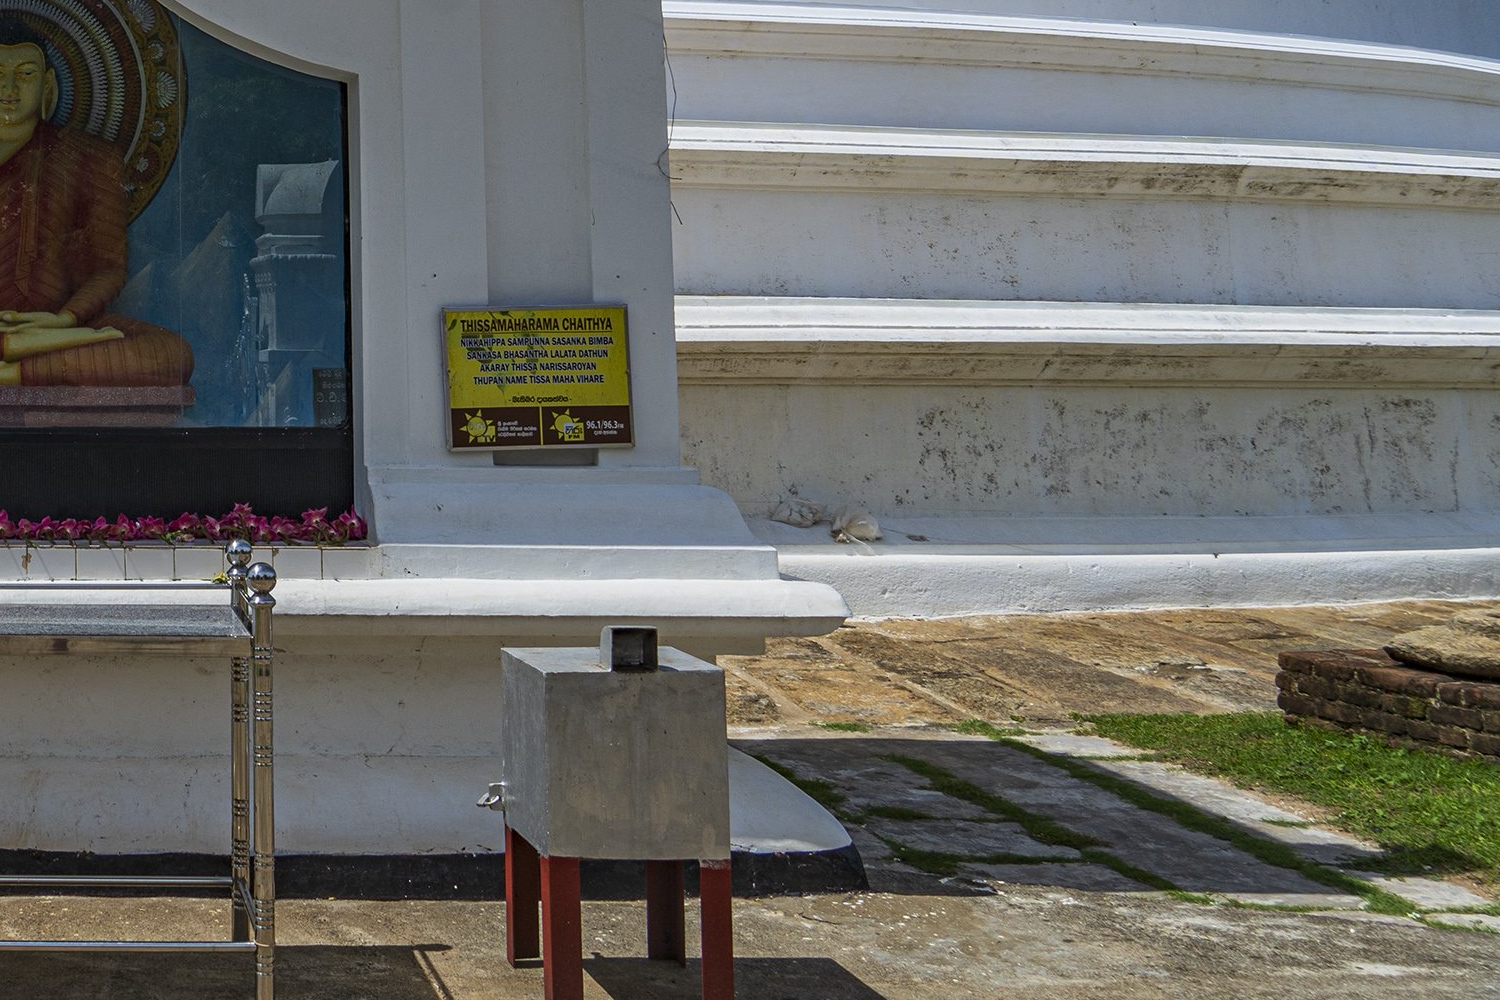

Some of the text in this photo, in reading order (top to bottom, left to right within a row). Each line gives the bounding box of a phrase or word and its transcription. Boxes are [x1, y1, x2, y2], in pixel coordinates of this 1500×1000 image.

[461, 318, 612, 332] THISSAMAHARAMA CHAITHYA
[461, 337, 613, 348] NIKKAHIPPA SAMPUNNA SASANKA BIMBA
[467, 349, 608, 360] SANKASA BHASANTHA LALATA DATHUN
[480, 363, 596, 372] AKARAY THISSA NARISSAROYAN
[474, 375, 604, 385] THUPAN NAME TISSA MAHA VIHARE
